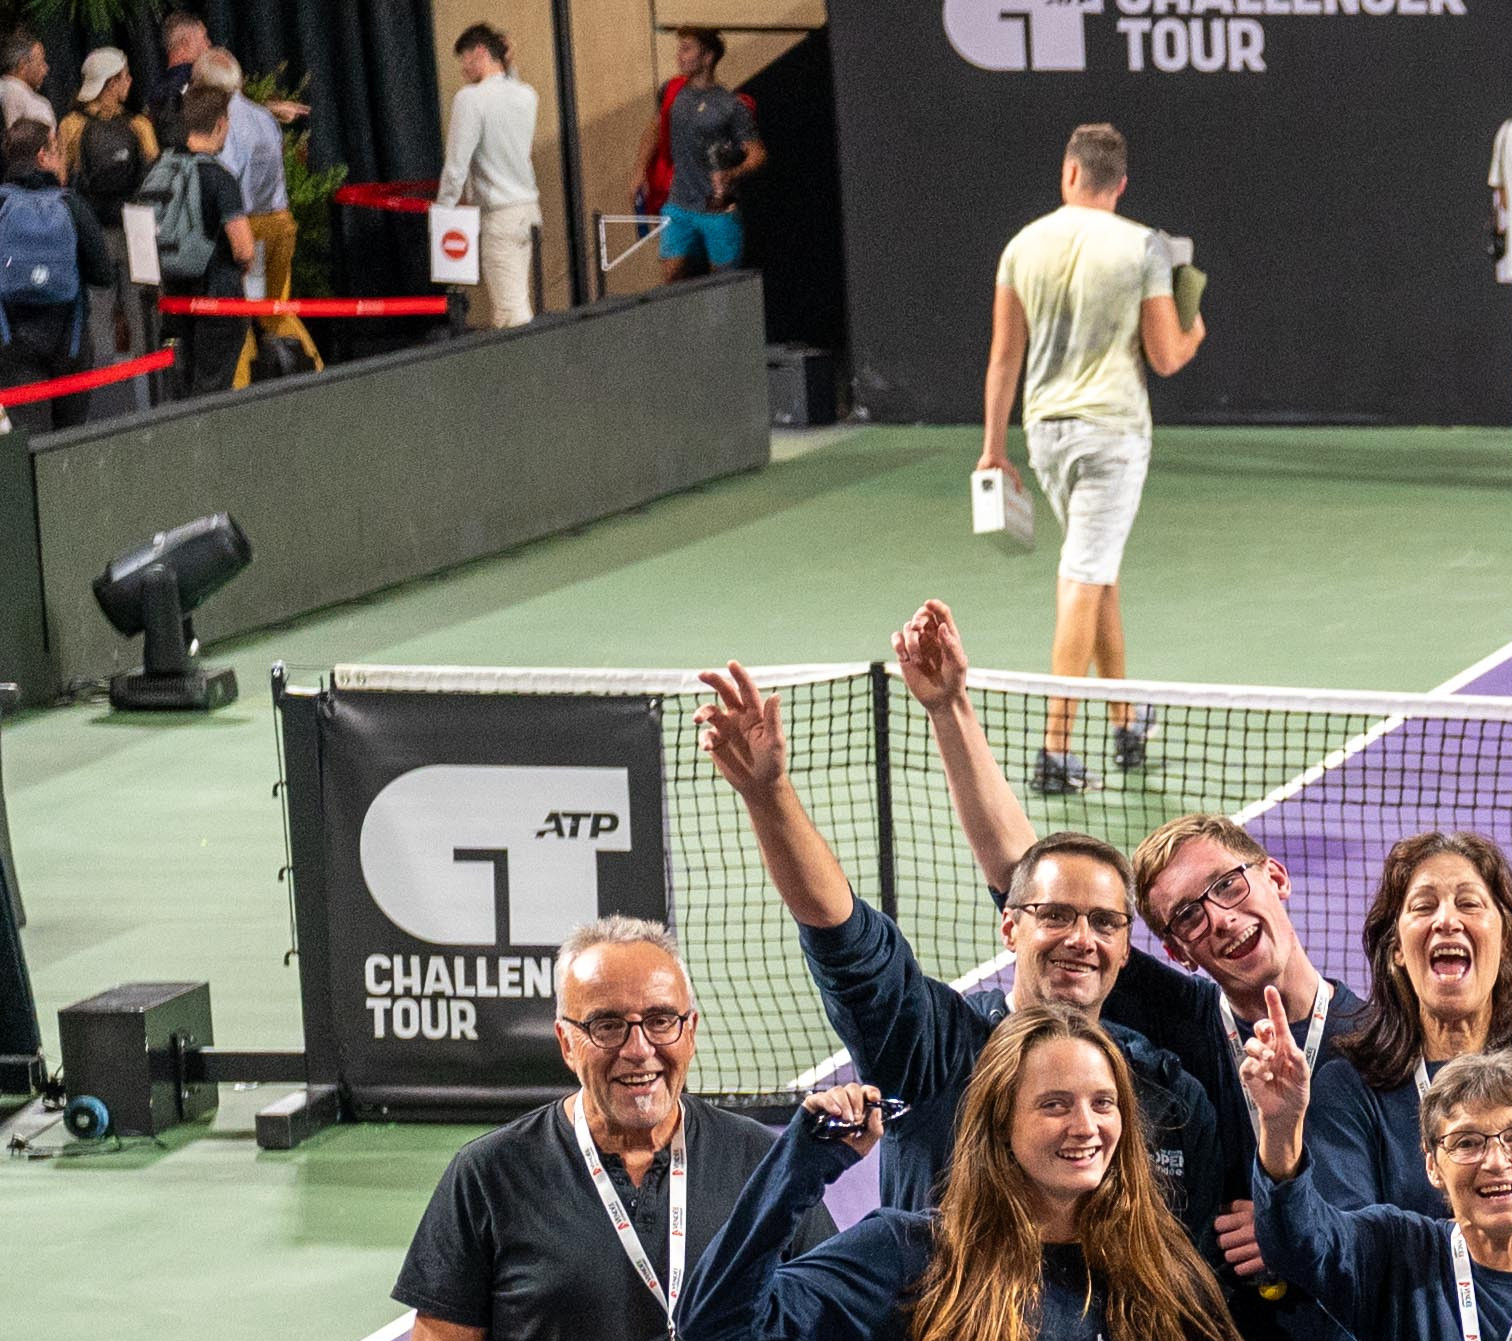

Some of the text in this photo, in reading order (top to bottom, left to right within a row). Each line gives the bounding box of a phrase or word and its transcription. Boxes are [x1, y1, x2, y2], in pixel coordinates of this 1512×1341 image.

[1117, 17, 1267, 72] TOUR
[535, 810, 619, 839] ATP
[365, 954, 557, 999] CHALLEN
[365, 998, 478, 1040] TOUR
